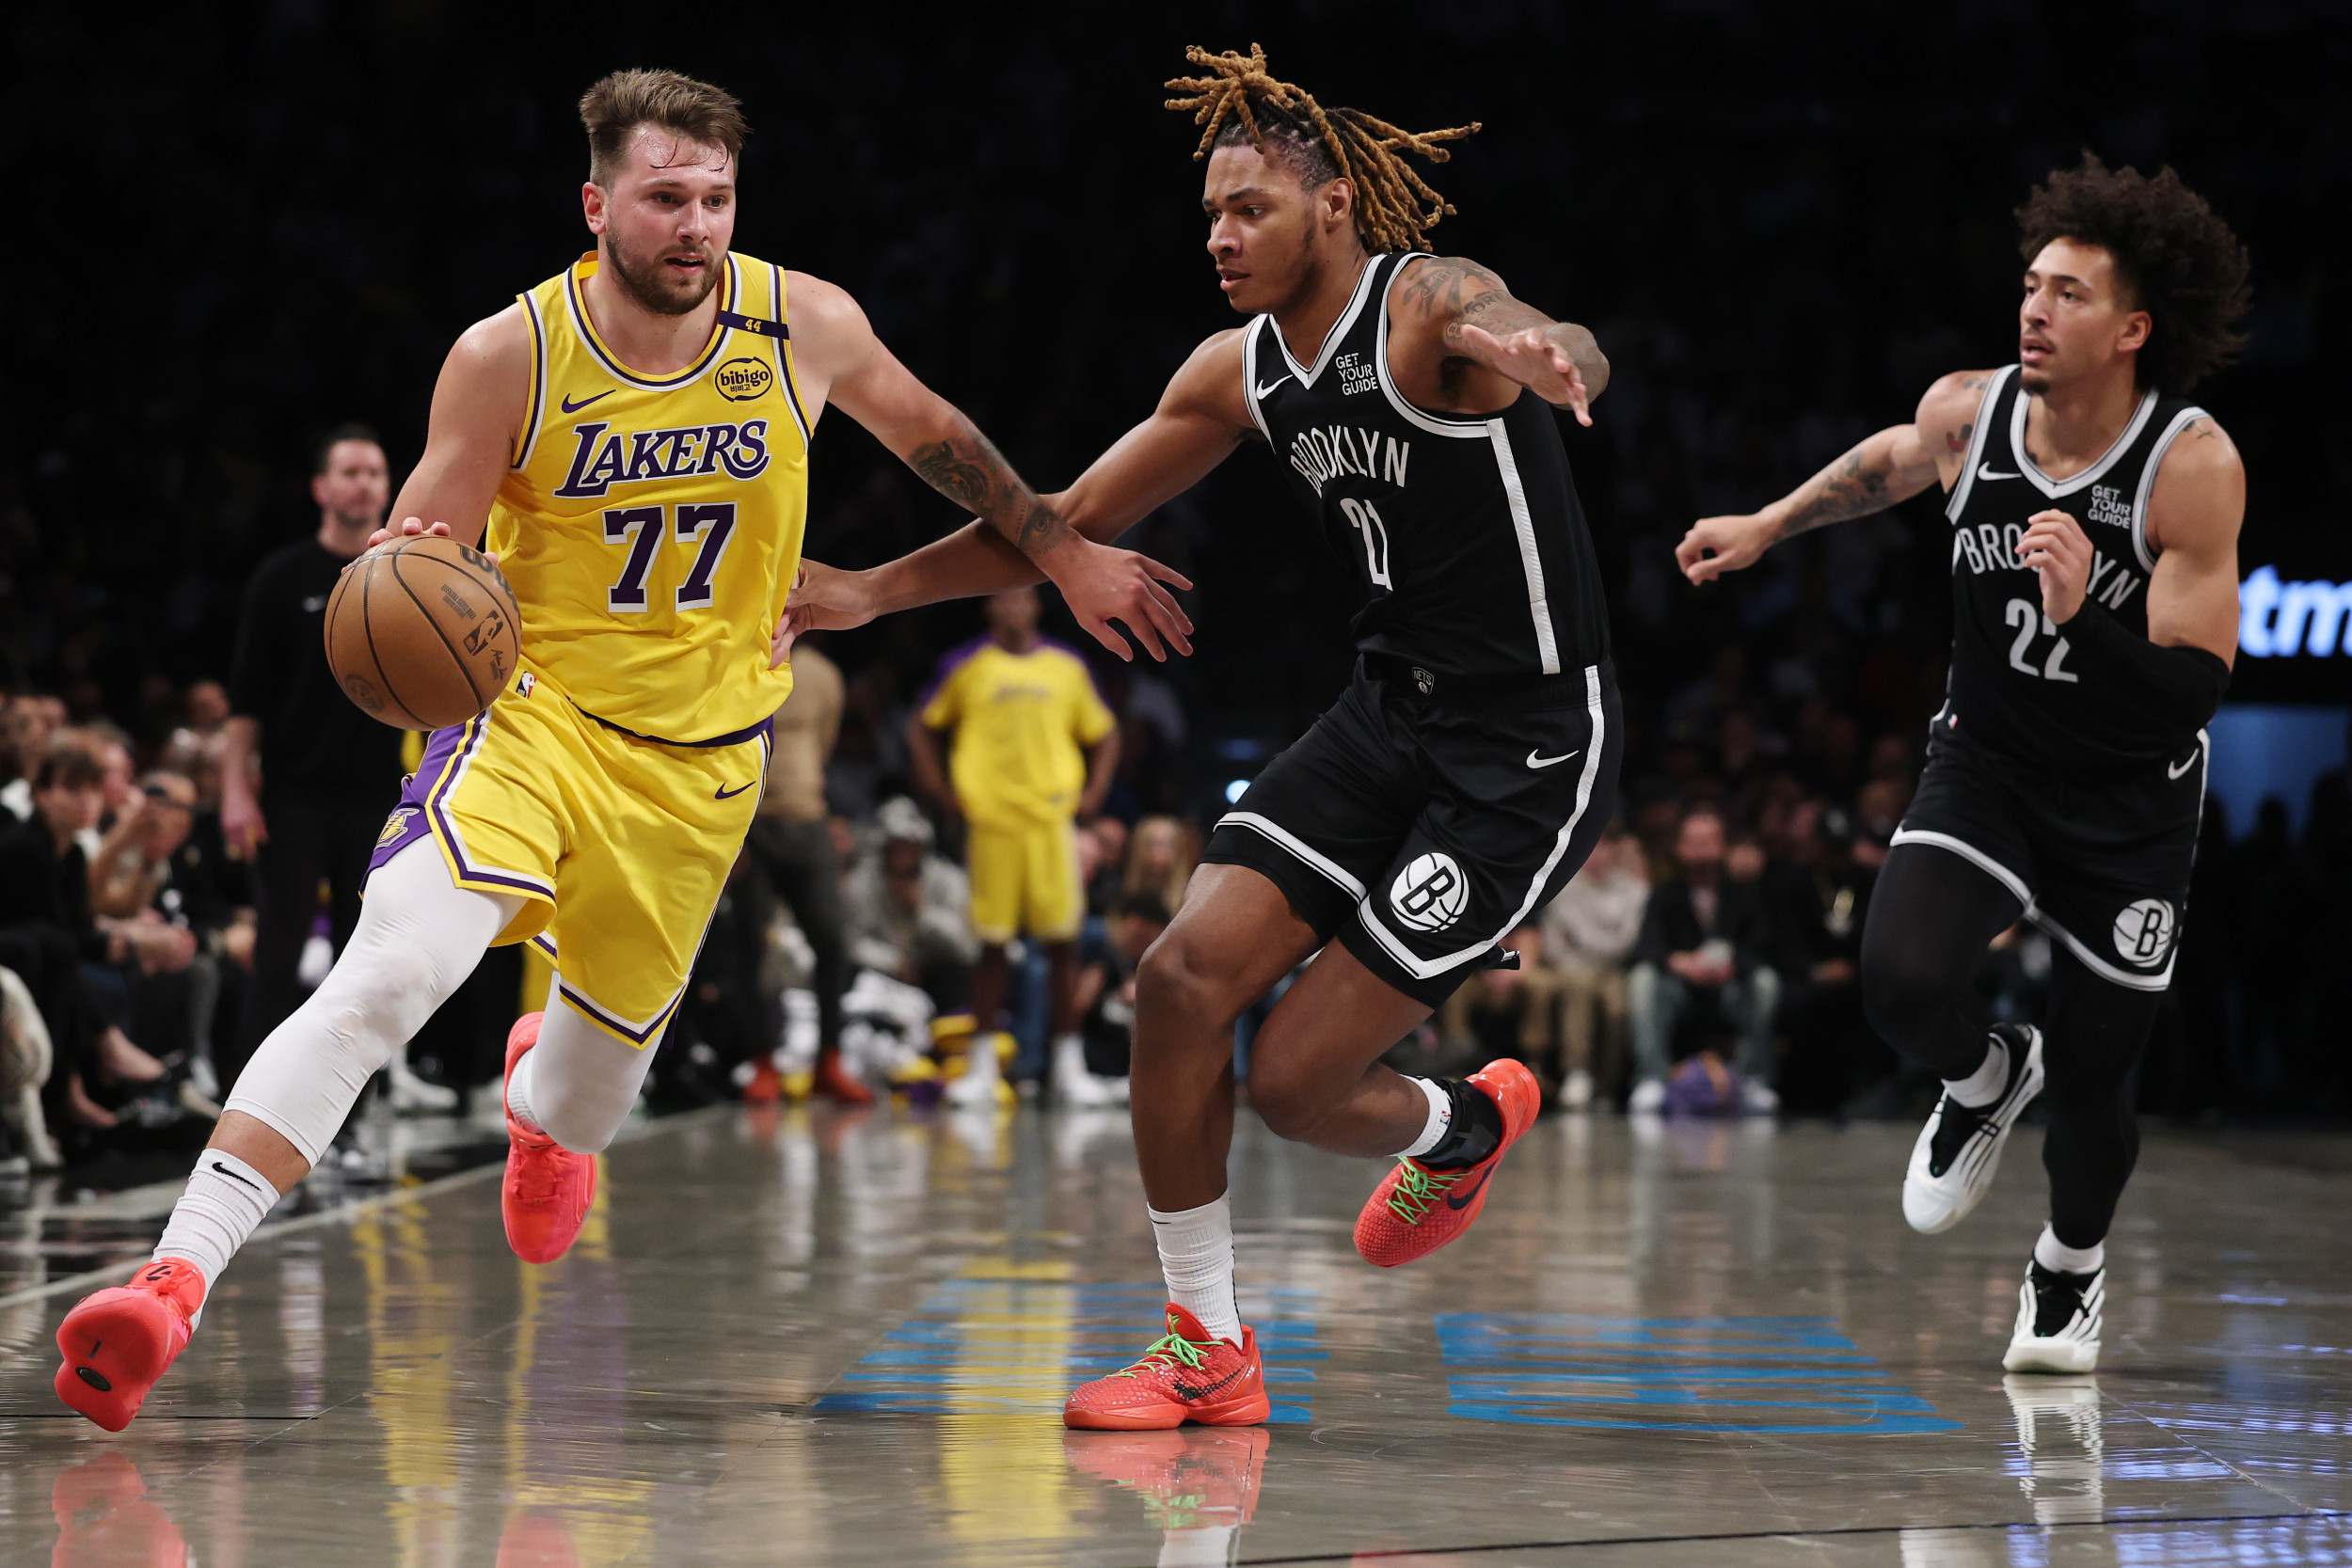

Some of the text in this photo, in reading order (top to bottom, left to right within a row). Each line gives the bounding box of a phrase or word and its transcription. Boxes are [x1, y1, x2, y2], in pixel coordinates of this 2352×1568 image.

[745, 319, 762, 332] 44
[1336, 353, 1359, 370] GET
[720, 369, 770, 387] bibigo
[1338, 364, 1374, 383] YOUR
[1342, 377, 1378, 396] GUIDE
[552, 419, 772, 498] LAKERS
[1291, 425, 1410, 499] BROOKLYN
[2091, 484, 2122, 500] GET
[2090, 496, 2131, 516] YOUR
[2088, 508, 2131, 530] GUIDE
[601, 501, 738, 613] 77
[1958, 523, 2141, 610] BROYN
[2005, 598, 2078, 683] 22
[1413, 670, 1432, 686] NETS
